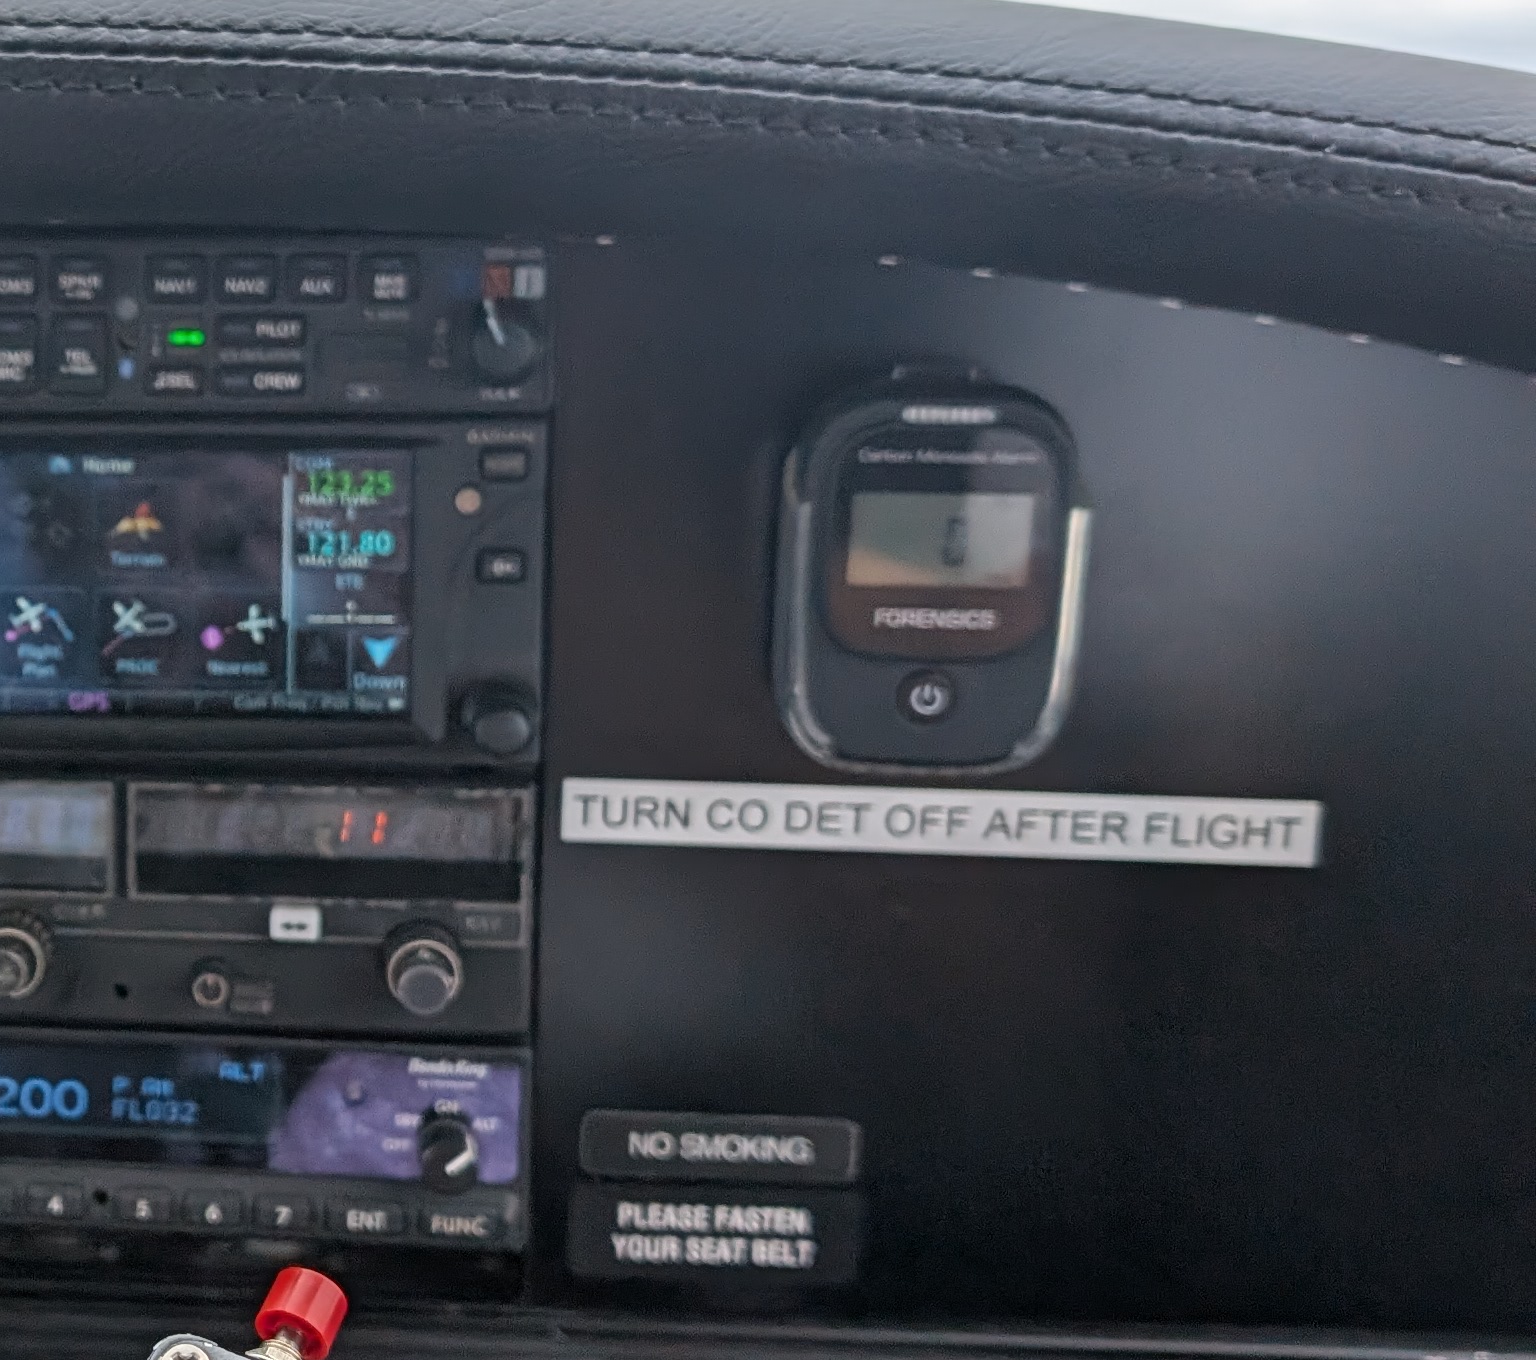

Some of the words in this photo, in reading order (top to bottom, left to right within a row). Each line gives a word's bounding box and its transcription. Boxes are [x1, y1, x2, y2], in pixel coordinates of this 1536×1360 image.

[300, 278, 334, 296] AUX
[82, 456, 136, 474] Home
[308, 529, 397, 557] 121.80
[873, 606, 997, 631] FORENSICS
[353, 672, 408, 691] Down
[573, 793, 692, 830] TURN
[705, 798, 770, 833] CO
[784, 800, 872, 835] DET
[884, 803, 974, 838] OFF
[981, 806, 1130, 845] AFTER
[1142, 811, 1303, 851] FLIGHT
[627, 1131, 677, 1161] NO
[679, 1132, 815, 1166] SMOKING
[46, 1194, 65, 1217] 4
[134, 1198, 153, 1221] 5
[204, 1203, 224, 1226] 6
[274, 1205, 295, 1227] 7
[345, 1209, 389, 1232] ENT
[430, 1214, 490, 1238] FUNC
[616, 1201, 710, 1233] PLEASE
[713, 1204, 814, 1236] FASTEN
[610, 1233, 682, 1265] YOUR
[684, 1235, 748, 1267] SEAT
[751, 1238, 816, 1270] BELT
